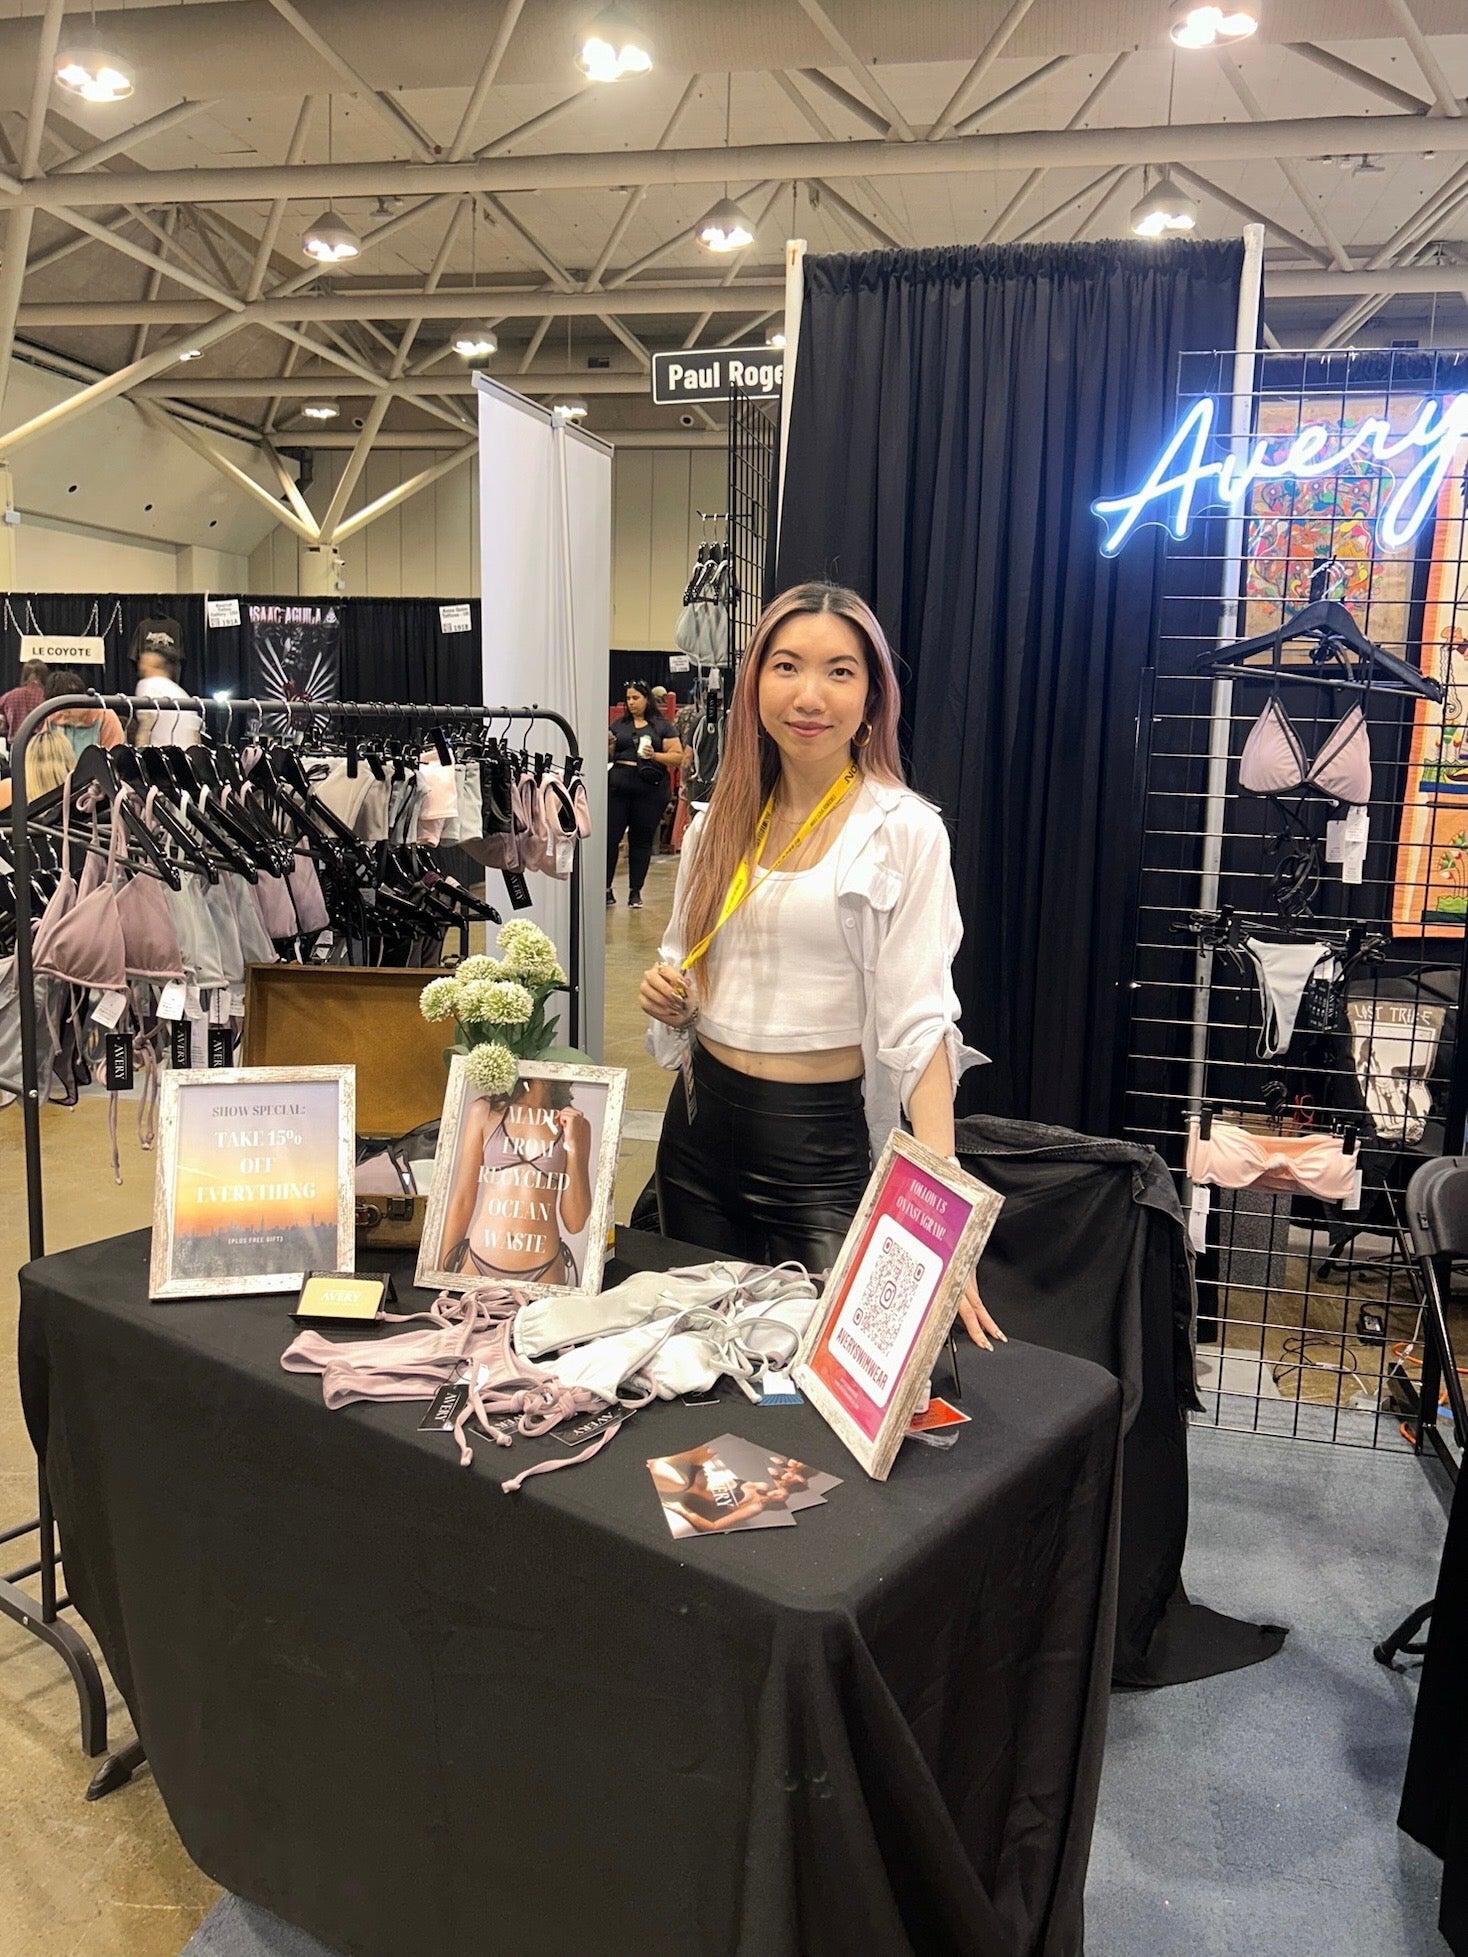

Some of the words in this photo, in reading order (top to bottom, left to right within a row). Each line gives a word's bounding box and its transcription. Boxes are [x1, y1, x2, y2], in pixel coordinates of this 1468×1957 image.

[668, 361, 720, 391] Paul
[1095, 391, 1468, 553] Avery
[249, 605, 281, 624] ISAAC
[32, 647, 45, 655] LE
[47, 647, 92, 656] COYOTE
[177, 1030, 186, 1065] AVERY
[213, 1039, 224, 1068] AVER
[114, 1044, 125, 1081] AVERY
[212, 1105, 249, 1118] SHOW
[507, 1105, 561, 1127] MADE
[214, 1129, 265, 1148] TAKE
[268, 1129, 303, 1146] 15%
[502, 1135, 555, 1158] FROM
[239, 1156, 275, 1174] OFF
[477, 1165, 571, 1191] RECYCLED
[195, 1182, 317, 1204] EVERYTHING
[488, 1197, 552, 1222] OCEAN
[483, 1228, 548, 1254] WASTE
[836, 1327, 889, 1391] AVERYSWIMWEAR
[434, 1392, 457, 1422] AVERY
[573, 1411, 613, 1437] AVERY
